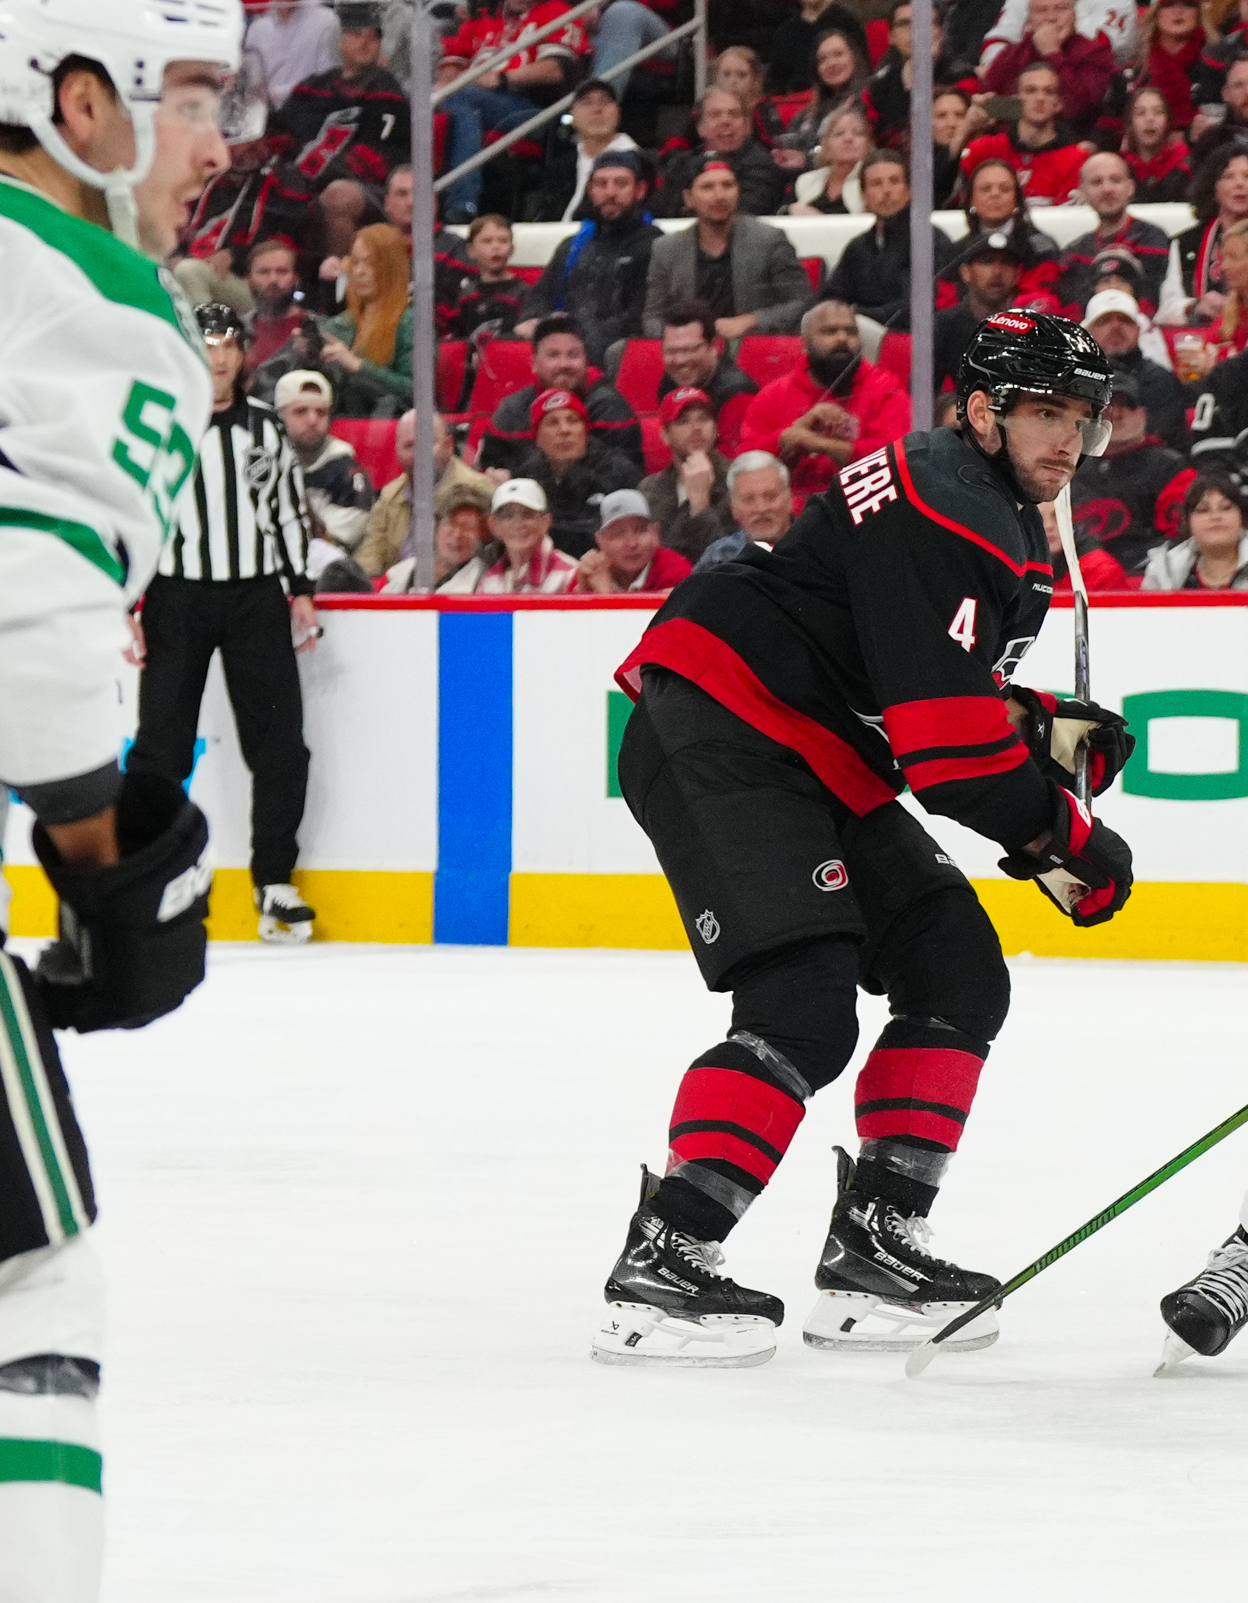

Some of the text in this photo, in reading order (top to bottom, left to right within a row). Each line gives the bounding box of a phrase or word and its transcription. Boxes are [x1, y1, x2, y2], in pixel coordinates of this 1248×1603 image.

[992, 313, 1029, 331] Lenovo
[1073, 367, 1107, 382] BAUER
[947, 596, 979, 653] 4
[656, 1266, 700, 1294] BAUER
[874, 1251, 924, 1281] BAUER
